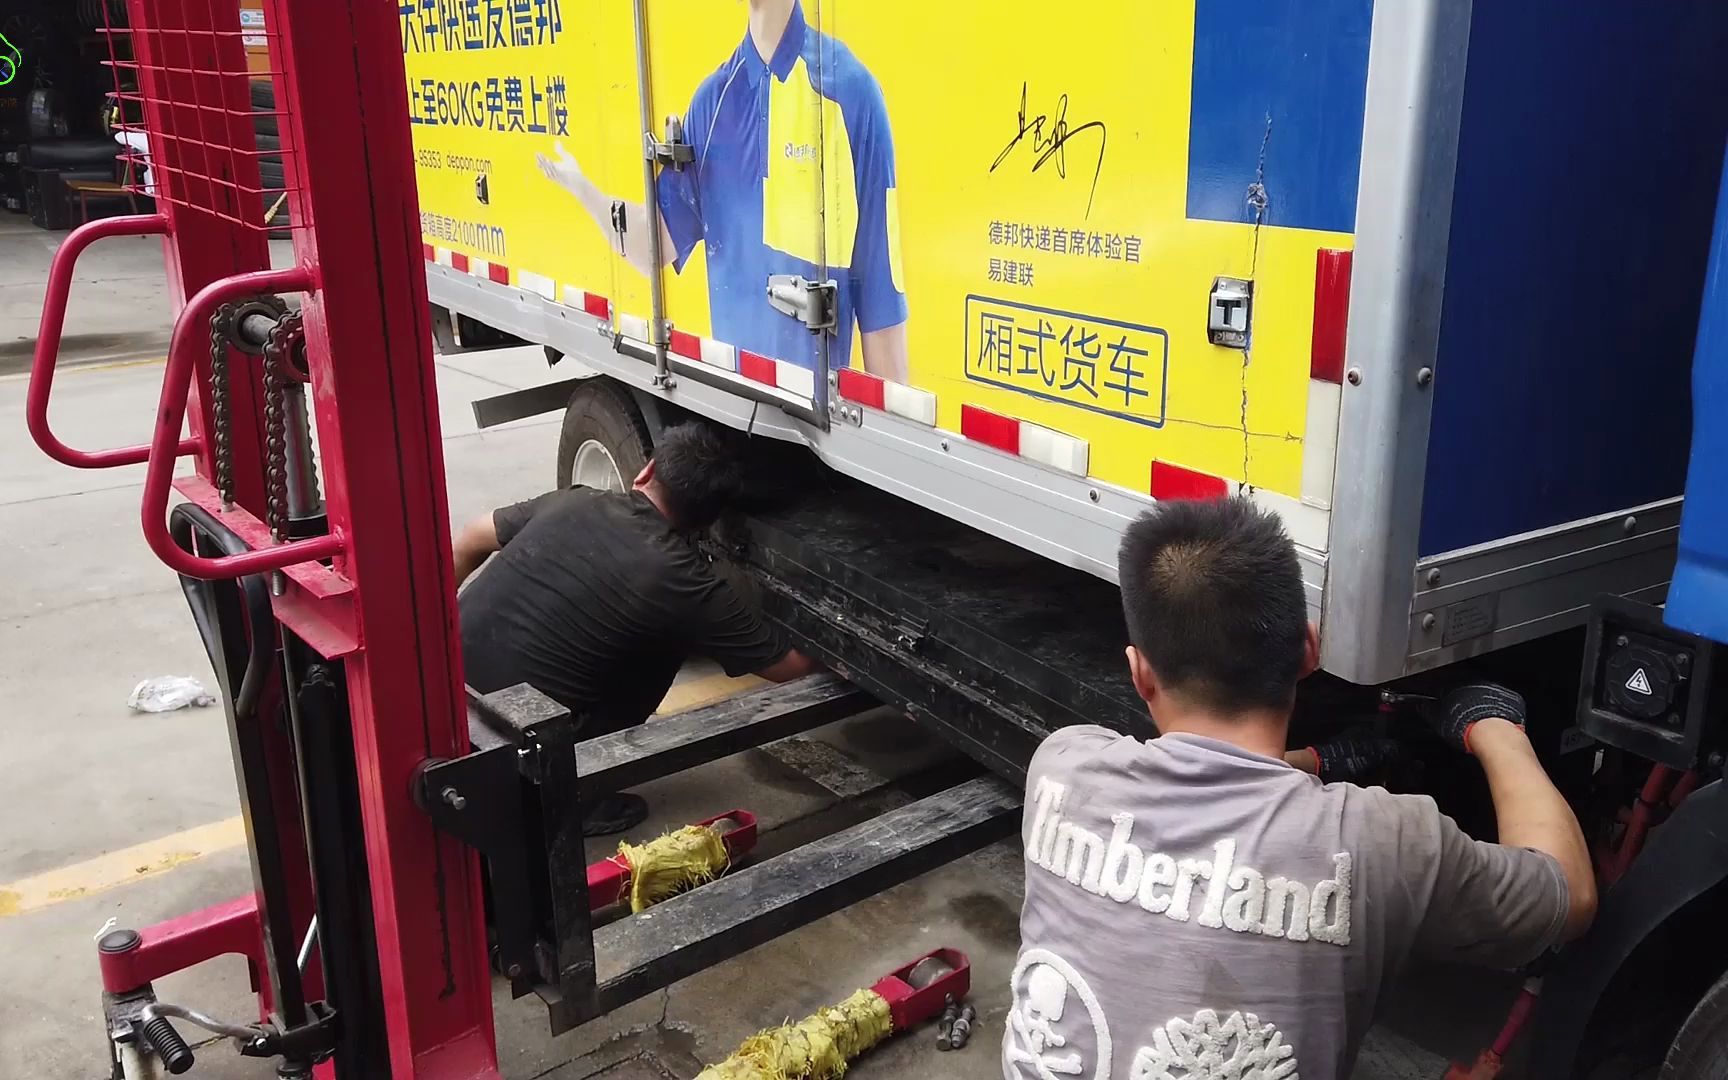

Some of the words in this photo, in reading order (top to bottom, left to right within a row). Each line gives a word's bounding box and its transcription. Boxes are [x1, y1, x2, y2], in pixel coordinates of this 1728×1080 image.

[988, 219, 1142, 264] 德邦快递首席体验官
[988, 257, 1034, 288] 易建联
[977, 311, 1149, 407] 厢式货车
[1027, 775, 1352, 946] Timberland
